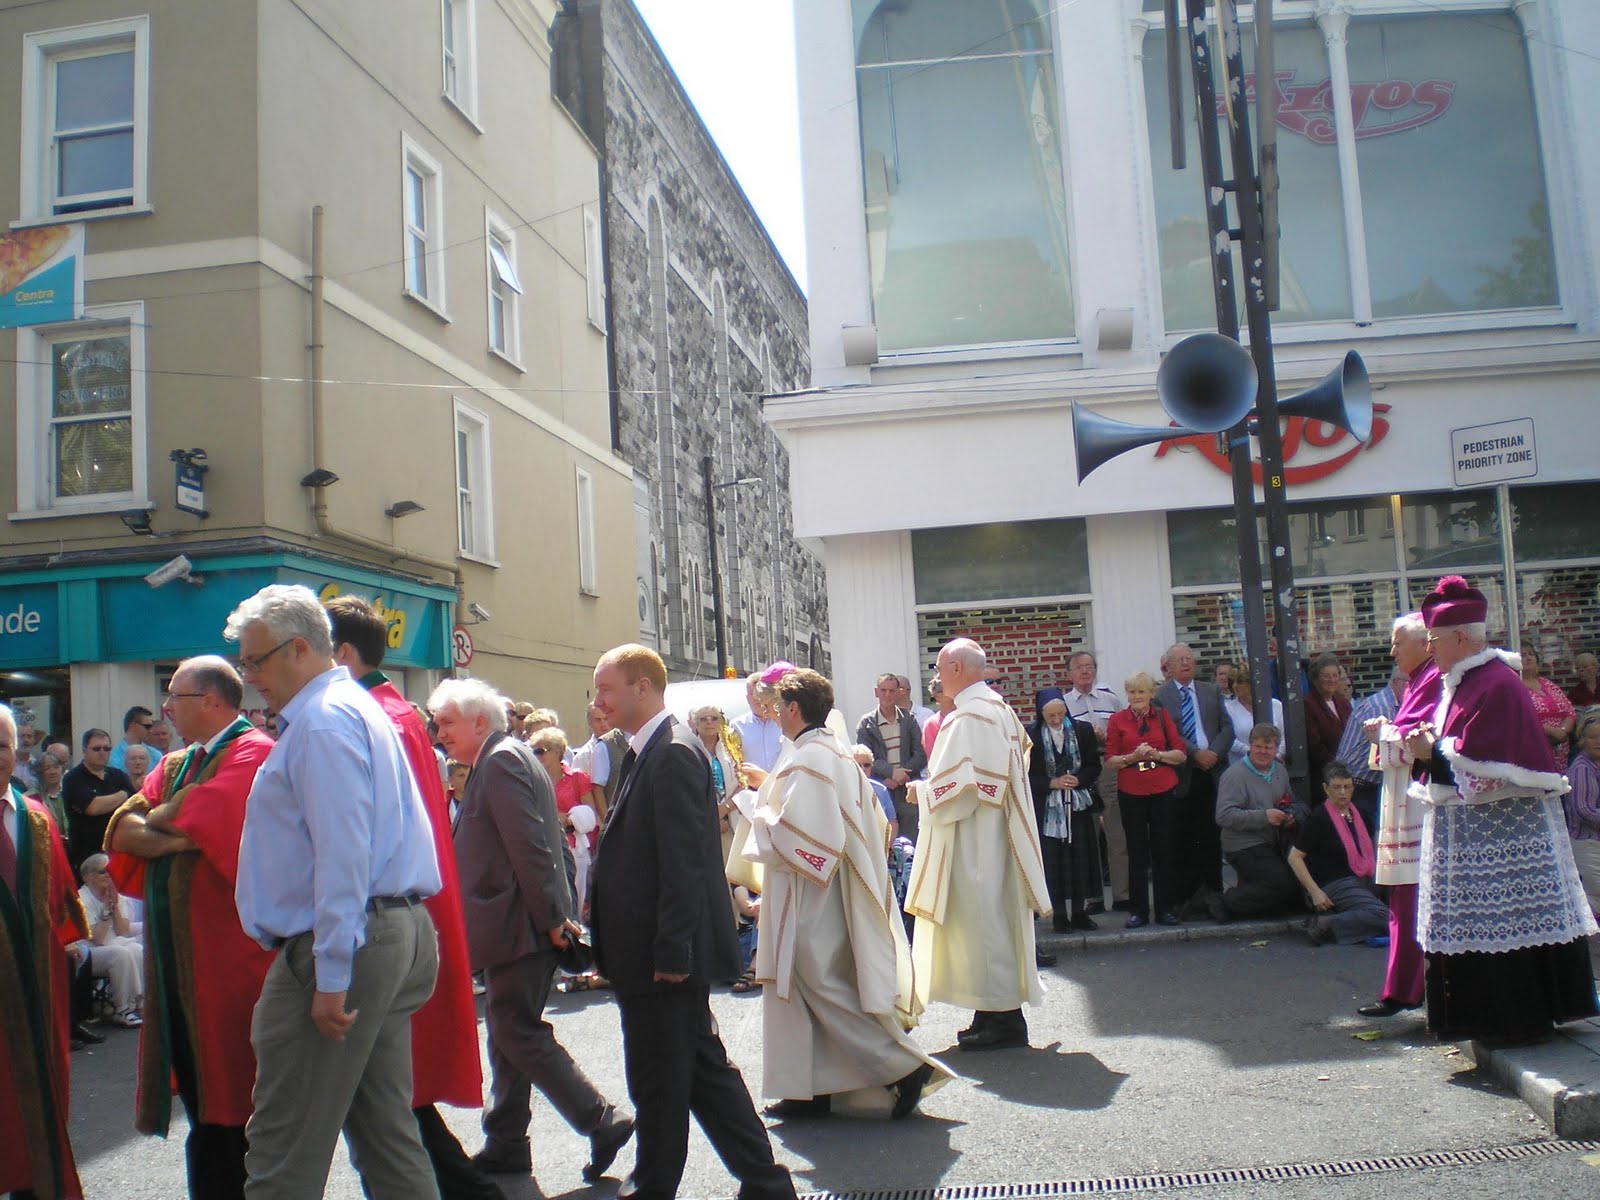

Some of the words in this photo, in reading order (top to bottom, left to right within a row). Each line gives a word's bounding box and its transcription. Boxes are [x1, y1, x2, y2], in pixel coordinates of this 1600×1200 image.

[15, 289, 54, 302] Centra
[1463, 435, 1524, 454] PEDESTRIAN
[1458, 454, 1503, 470] PRIORITY
[1506, 449, 1532, 464] ZONE
[1271, 475, 1281, 487] 3
